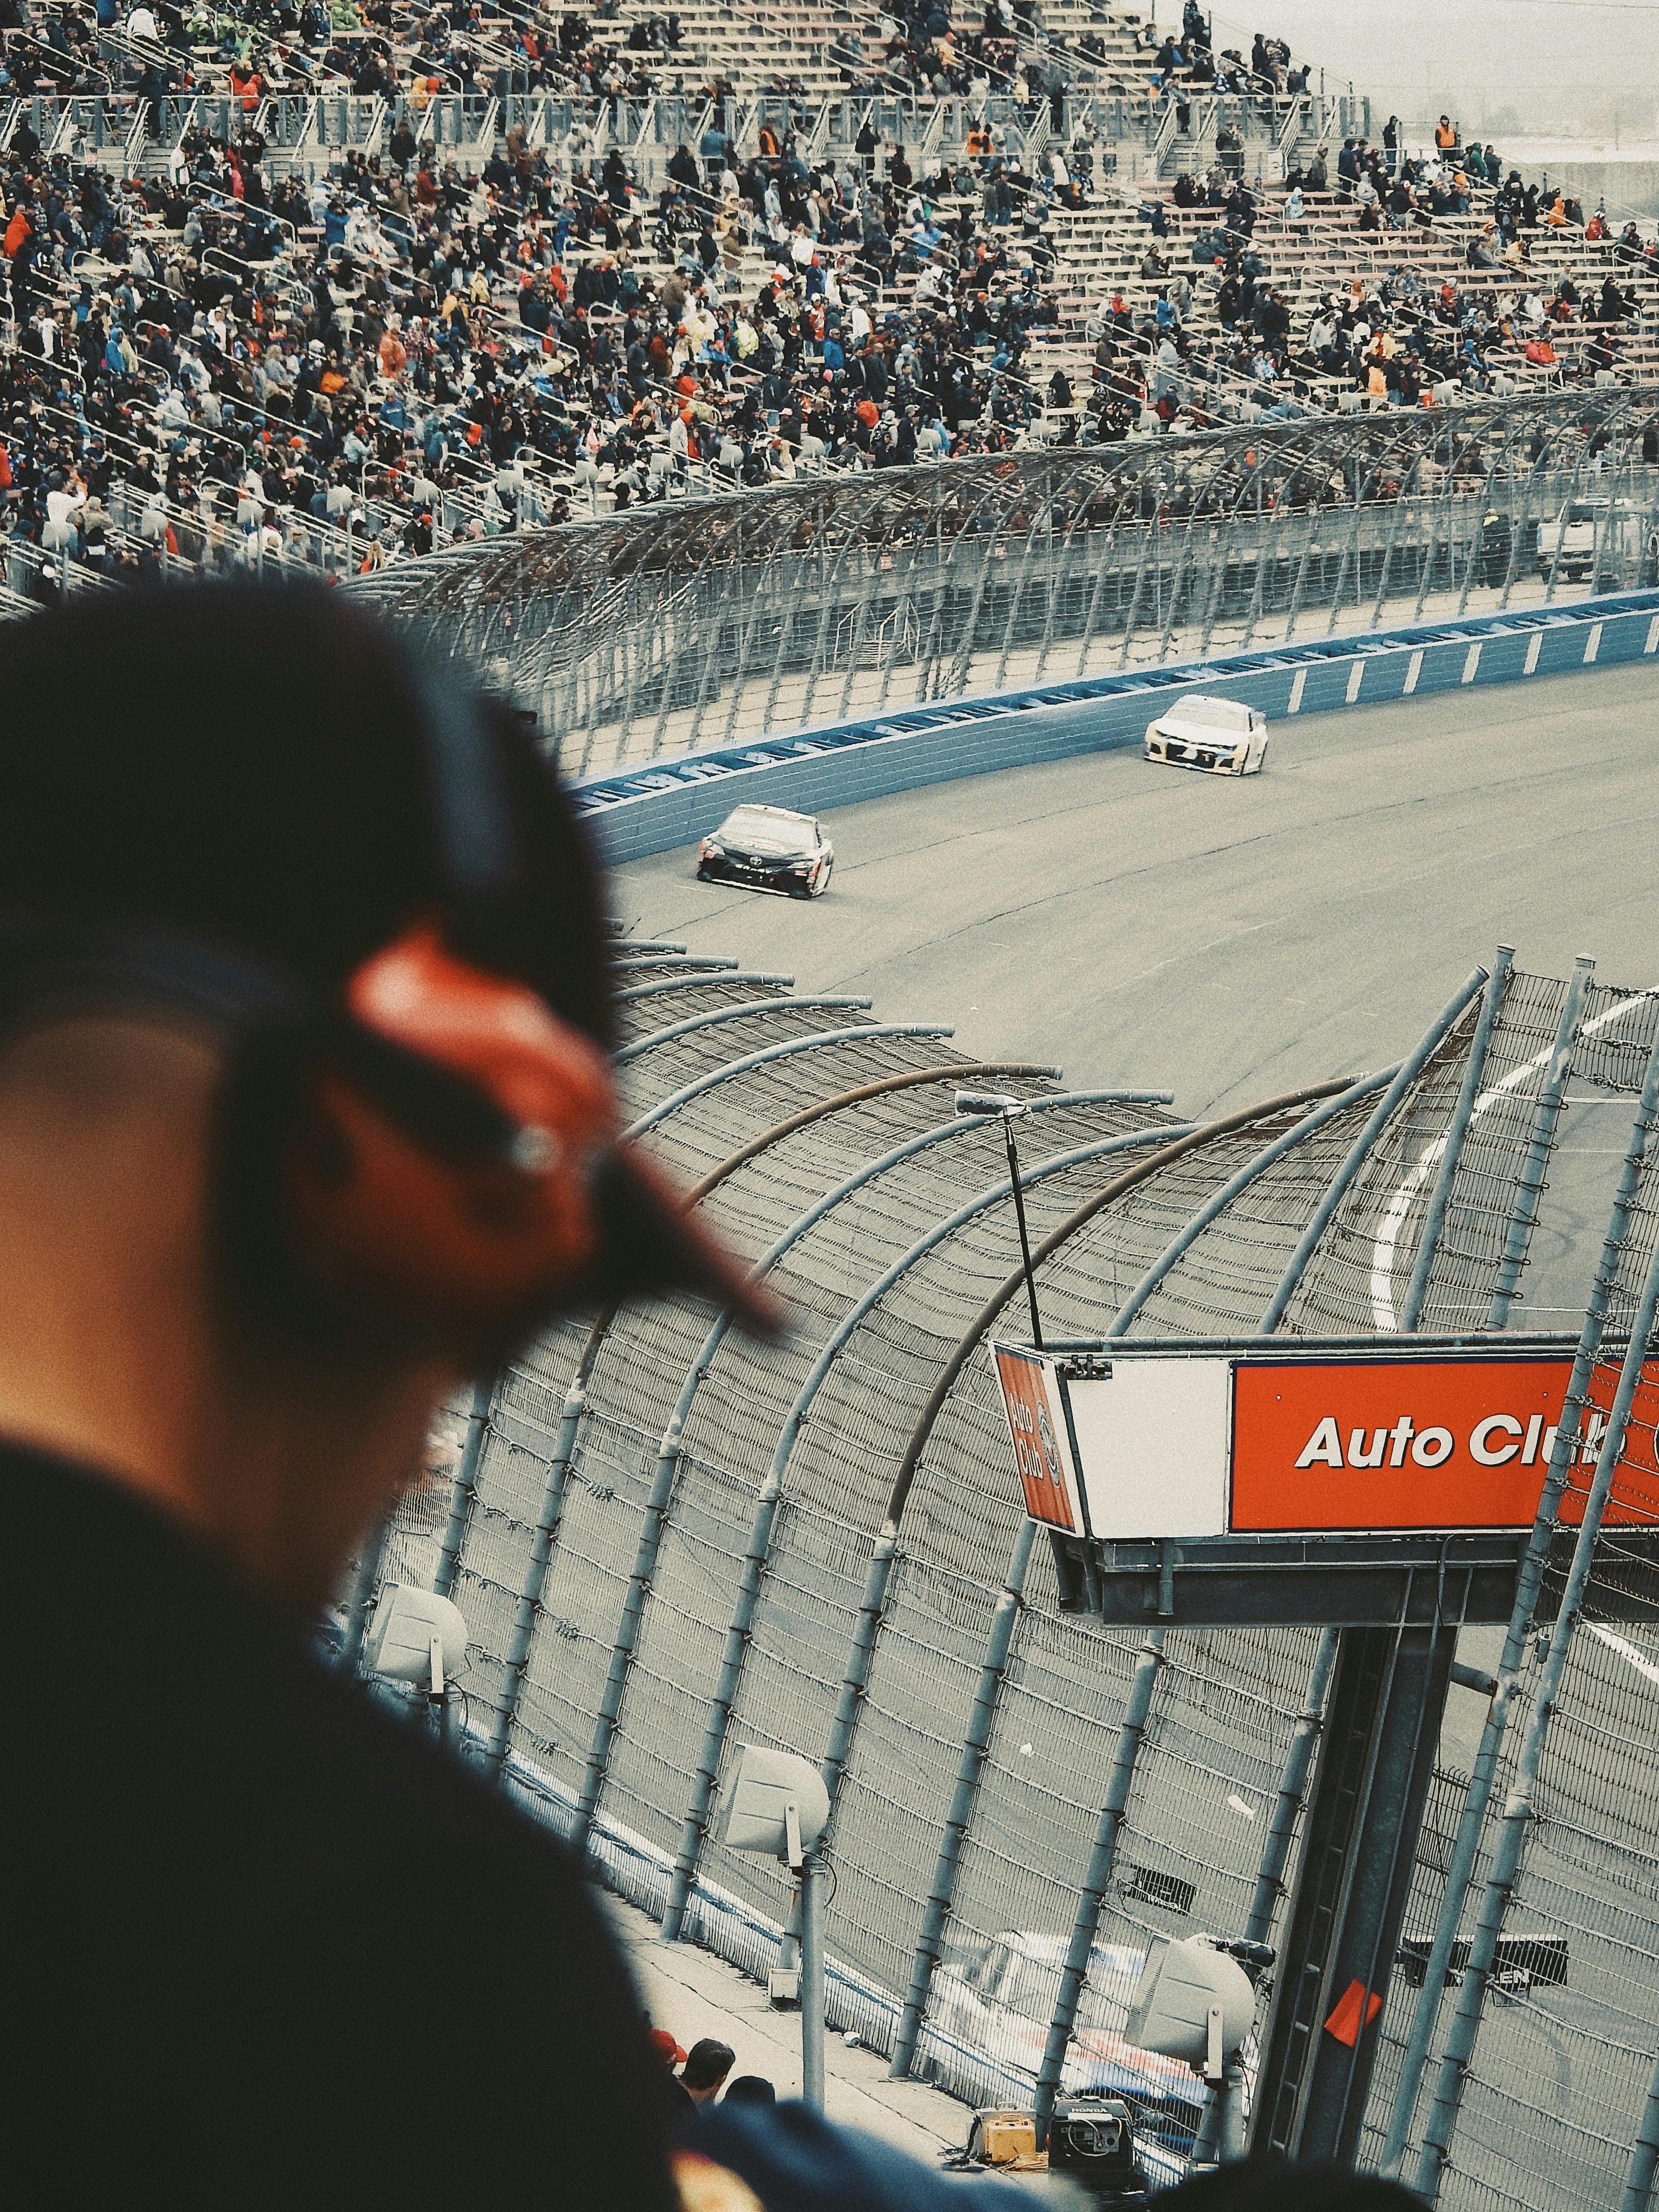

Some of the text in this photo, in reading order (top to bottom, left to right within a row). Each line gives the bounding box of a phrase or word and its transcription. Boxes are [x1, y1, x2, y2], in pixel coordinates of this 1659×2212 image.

[1010, 1392, 1033, 1434] Auto
[1019, 1438, 1043, 1479] Club
[1294, 1416, 1455, 1469] Auto
